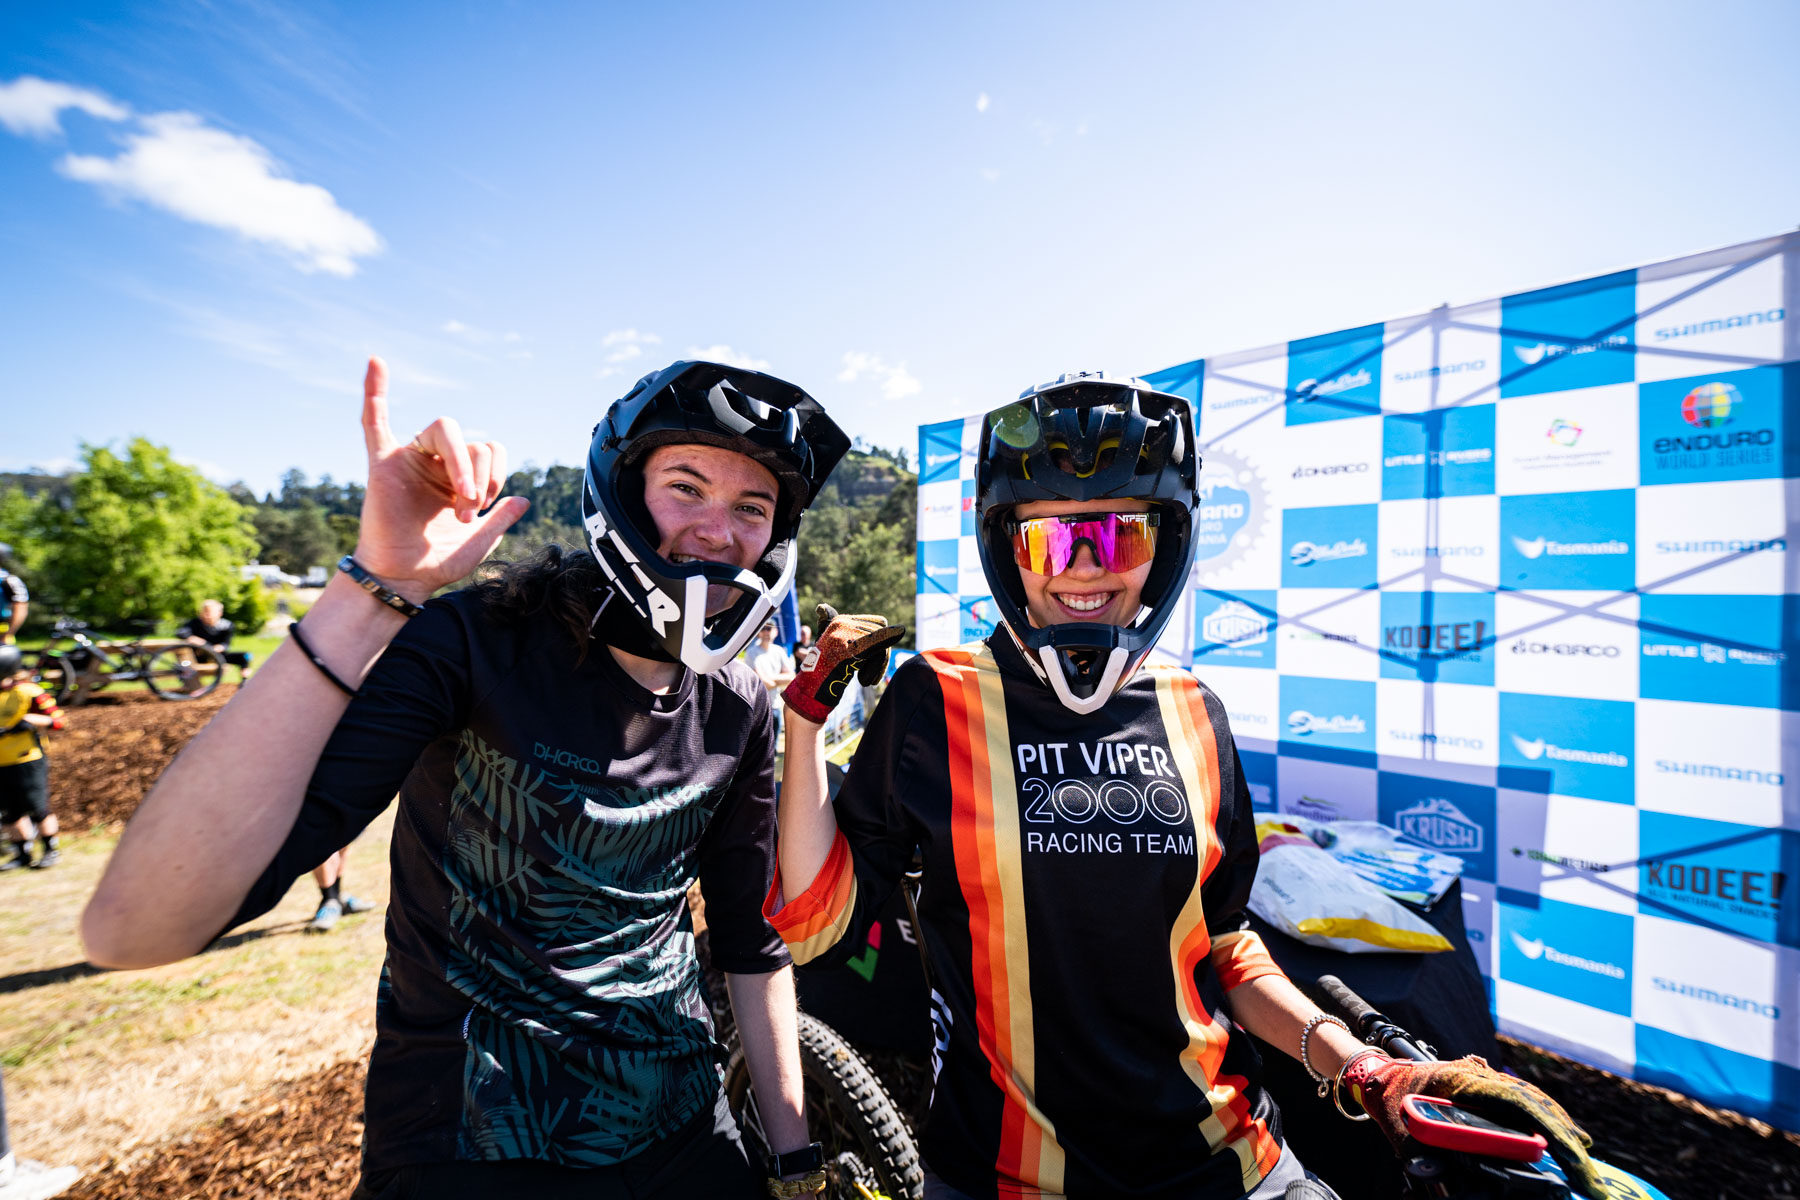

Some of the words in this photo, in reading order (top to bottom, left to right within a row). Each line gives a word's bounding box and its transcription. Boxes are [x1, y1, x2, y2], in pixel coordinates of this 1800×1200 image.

[1654, 308, 1785, 342] SHIMANO
[1020, 520, 1046, 551] PIT
[1116, 514, 1148, 541] VIPER
[1546, 540, 1629, 555] Tasmania
[1655, 539, 1786, 553] SHIMANO
[1017, 742, 1068, 775] PIT
[1079, 742, 1176, 778] VIPER
[1544, 744, 1628, 767] Tasmania
[1655, 759, 1785, 786] SHIMANO
[1021, 777, 1188, 826] 2000
[1027, 832, 1122, 854] RACING
[1130, 833, 1194, 856] TEAM
[1403, 815, 1474, 848] KRUSH
[1543, 945, 1625, 980] Tasmania
[1651, 976, 1780, 1020] SHIMANO
